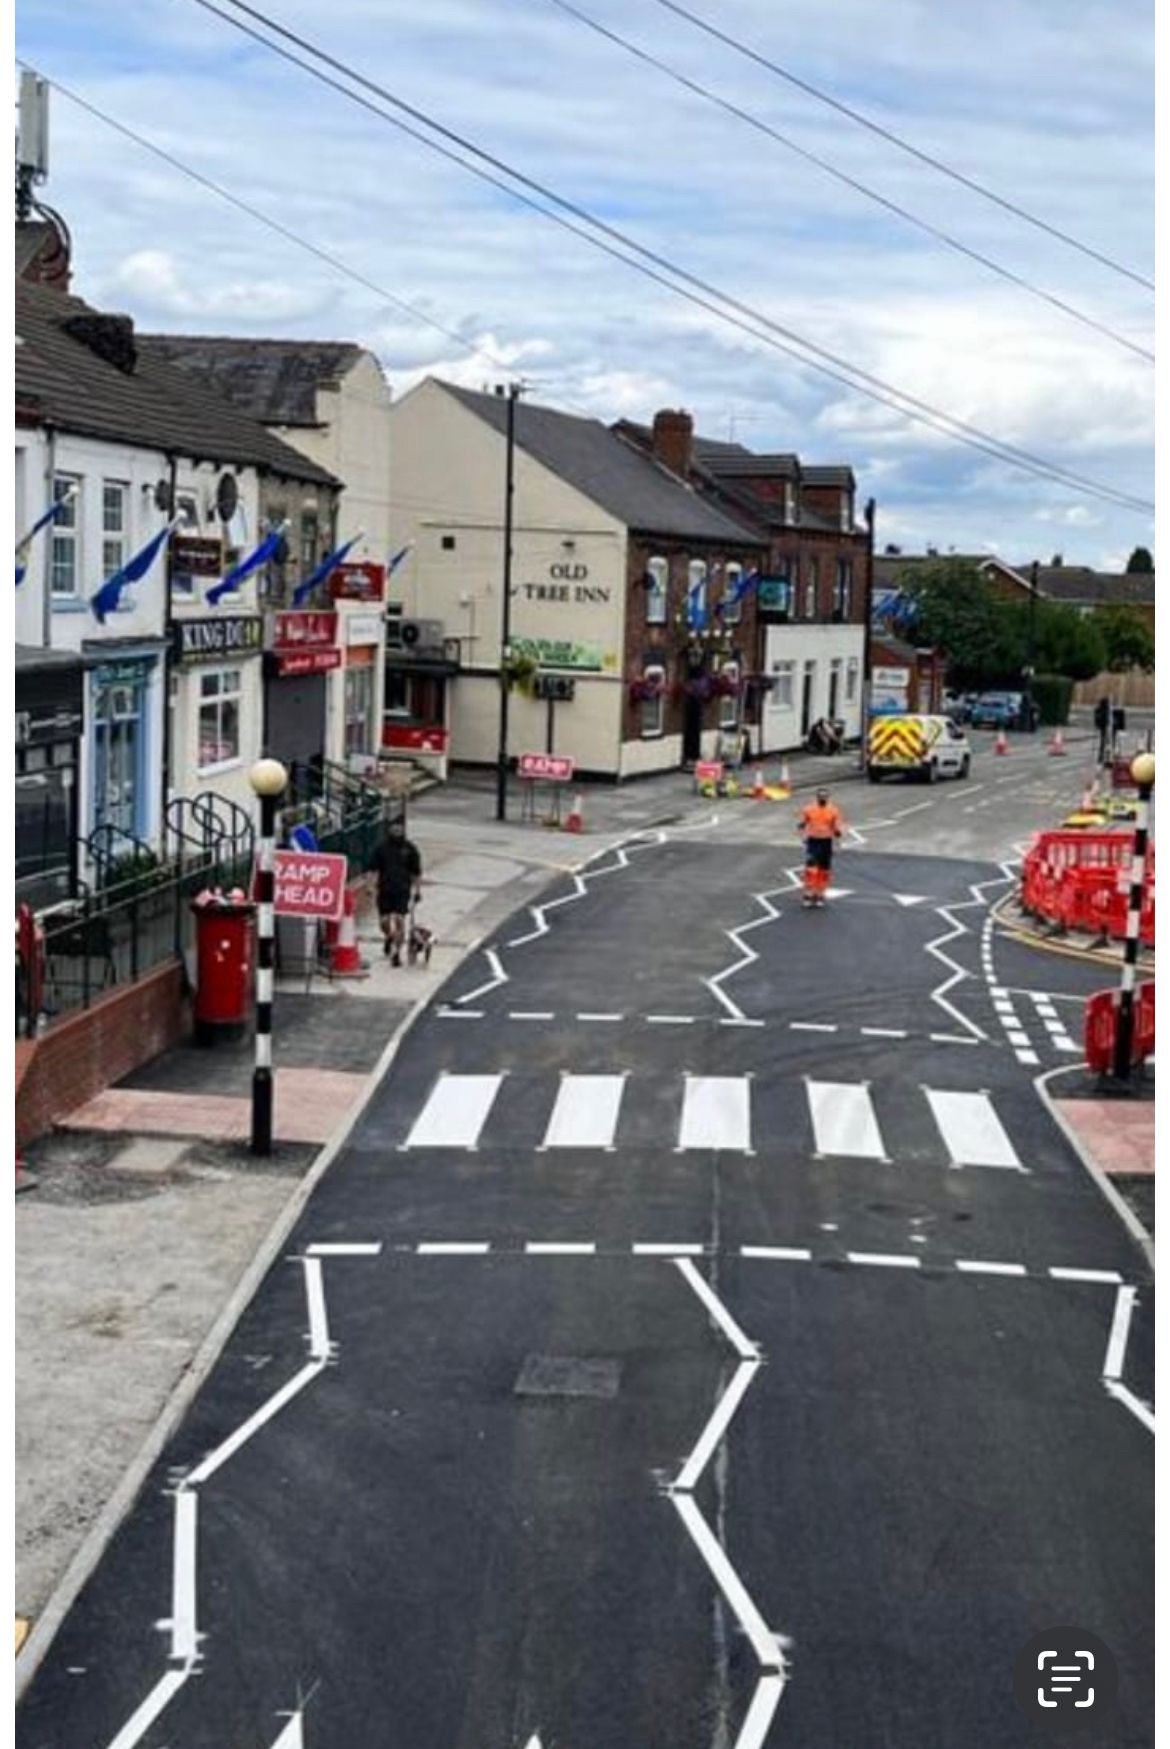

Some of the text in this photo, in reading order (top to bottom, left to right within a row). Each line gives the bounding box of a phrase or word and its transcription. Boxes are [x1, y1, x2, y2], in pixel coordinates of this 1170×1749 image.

[550, 563, 588, 580] OLD
[522, 583, 569, 602] TREE
[575, 585, 611, 602] INN
[274, 884, 334, 907] HEAD
